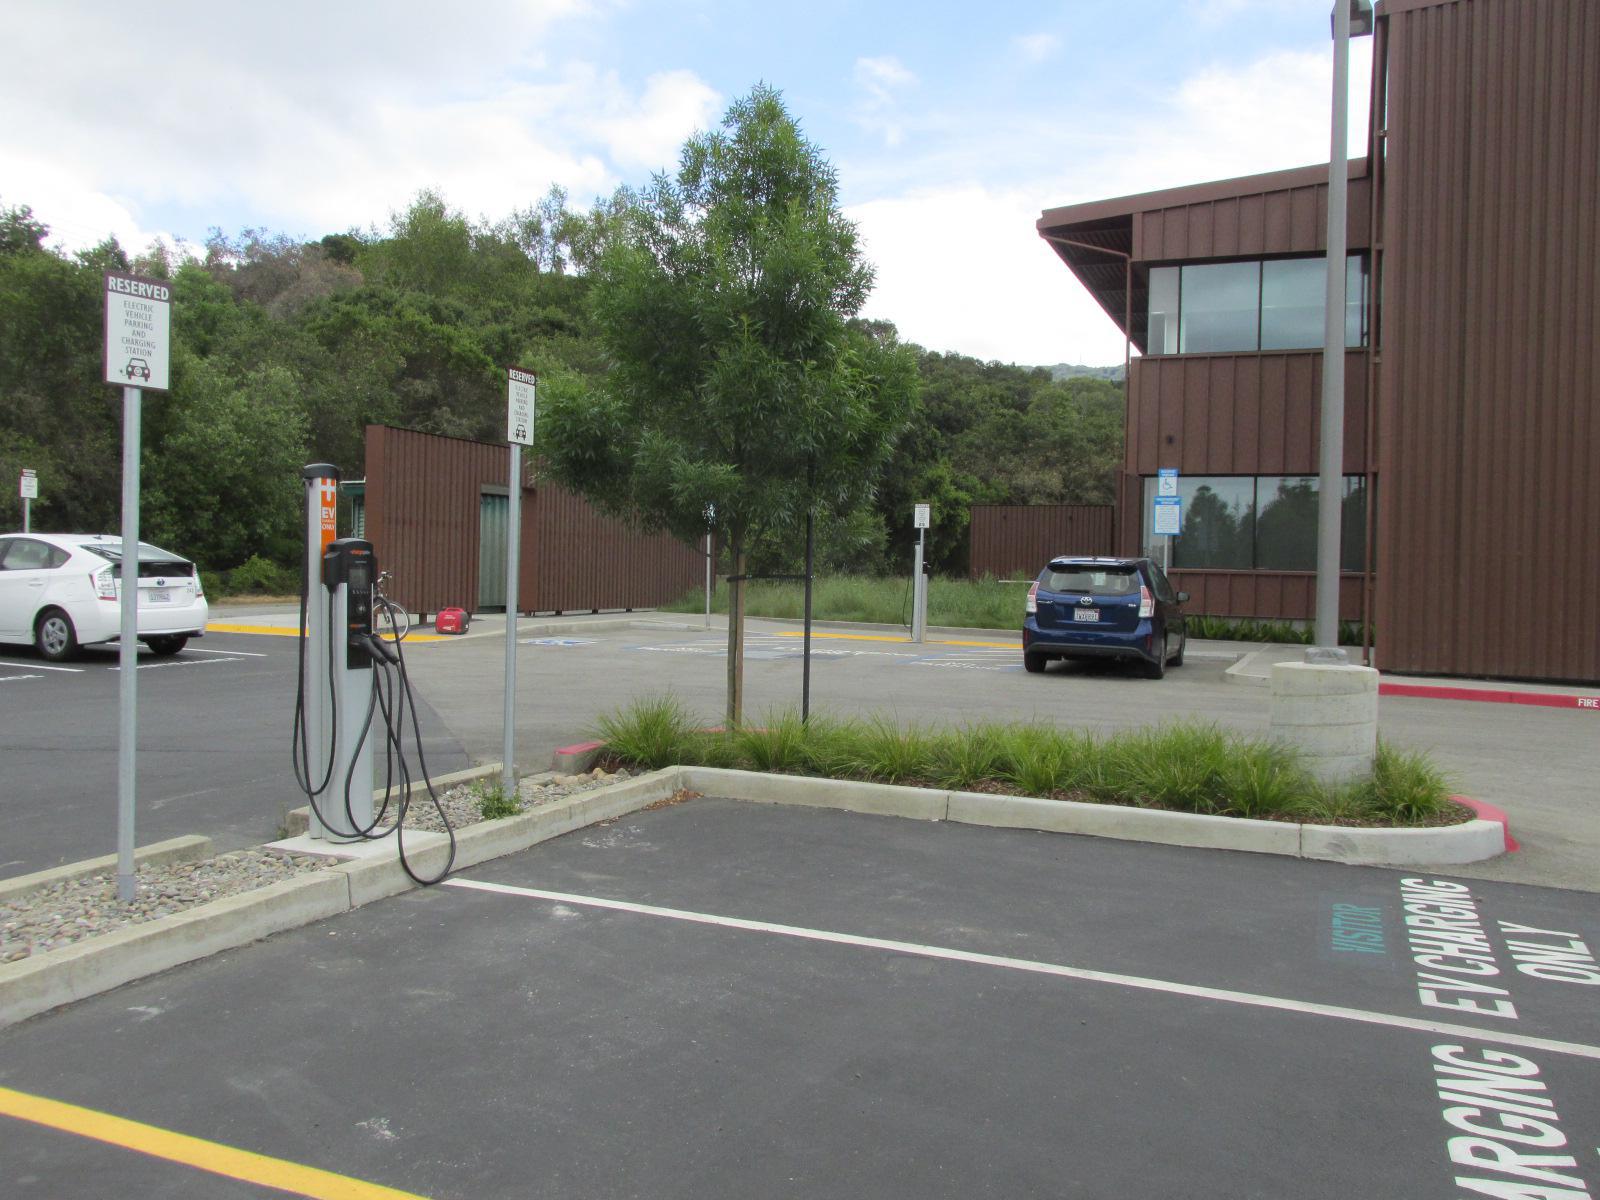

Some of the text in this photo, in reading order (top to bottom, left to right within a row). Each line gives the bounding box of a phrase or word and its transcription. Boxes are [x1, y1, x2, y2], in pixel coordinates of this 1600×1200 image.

[108, 276, 169, 300] RESERVED
[124, 301, 153, 312] ELECTRIC
[125, 310, 152, 322] VEHICLE
[125, 319, 153, 331] PARKING
[132, 330, 146, 338] AND
[122, 337, 156, 349] CHARGING
[125, 346, 152, 357] STATION
[509, 369, 535, 384] RESERVED
[321, 507, 335, 518] EV
[1578, 698, 1599, 708] FIRE
[1332, 903, 1386, 954] VISITOR
[1401, 878, 1518, 1019] EV CHARGING
[1497, 920, 1600, 985] ONLY
